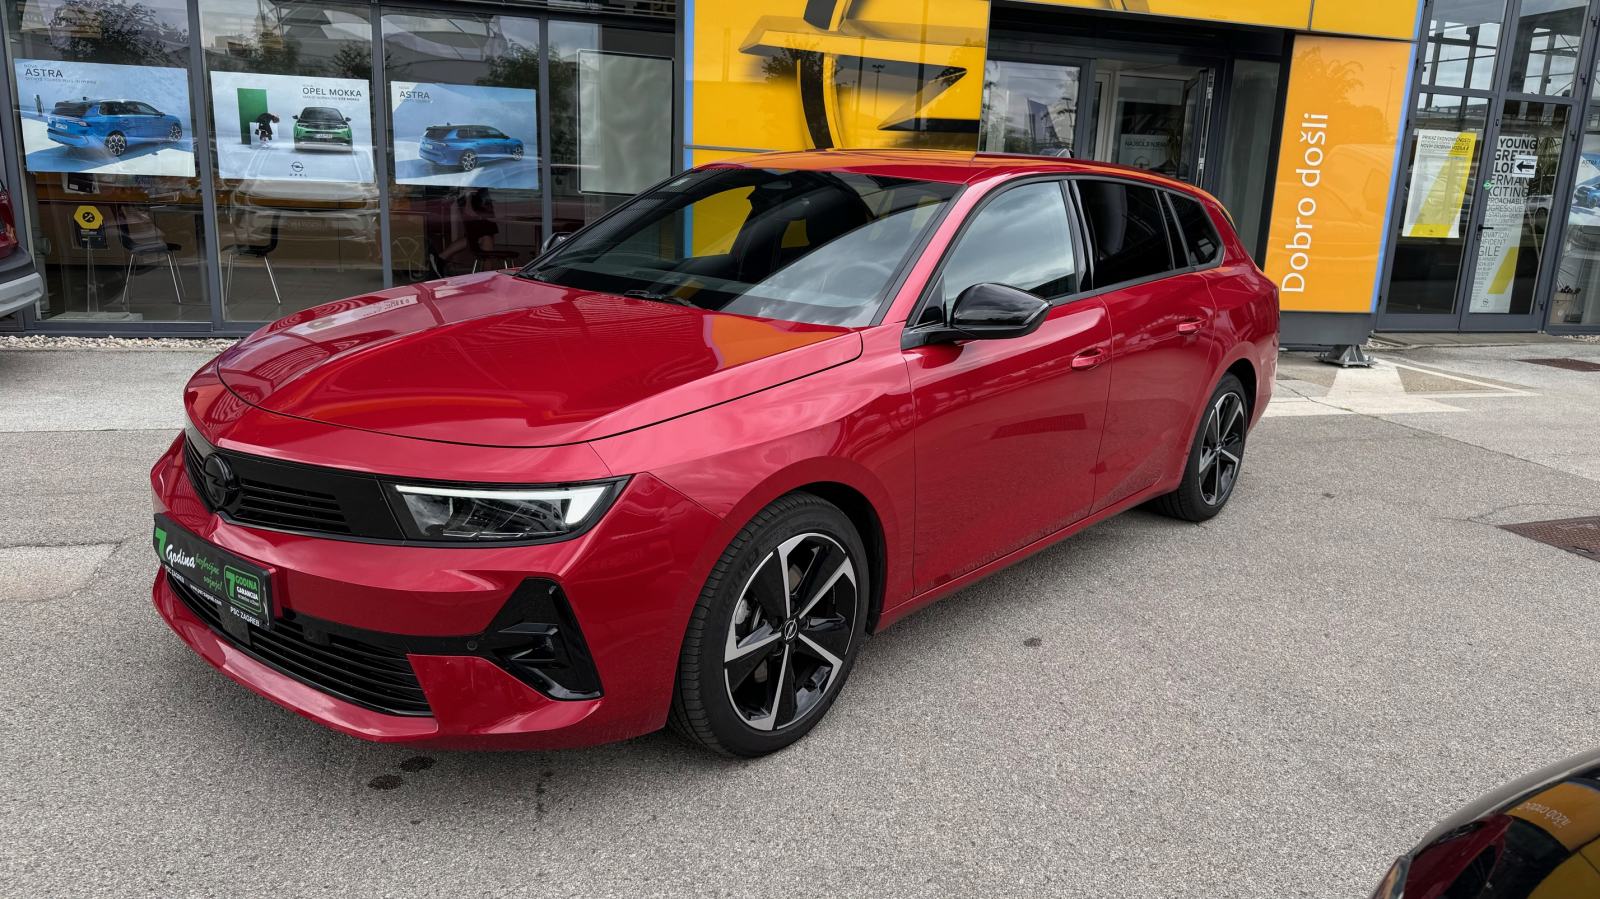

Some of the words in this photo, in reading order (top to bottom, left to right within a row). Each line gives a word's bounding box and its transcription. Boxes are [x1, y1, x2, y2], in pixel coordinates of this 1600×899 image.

[25, 68, 63, 78] ASTRA
[302, 87, 326, 96] OPEL
[329, 88, 362, 97] MOKKA
[400, 90, 430, 99] ASTRA
[1296, 113, 1328, 187] došli
[1499, 138, 1537, 149] YOUNG
[1281, 197, 1316, 292] Dobro
[155, 527, 167, 561] 7
[166, 544, 196, 568] Godina
[225, 571, 235, 598] 7
[235, 575, 257, 591] GODINA
[230, 606, 240, 617] PSC
[240, 612, 260, 627] ZAGREB
